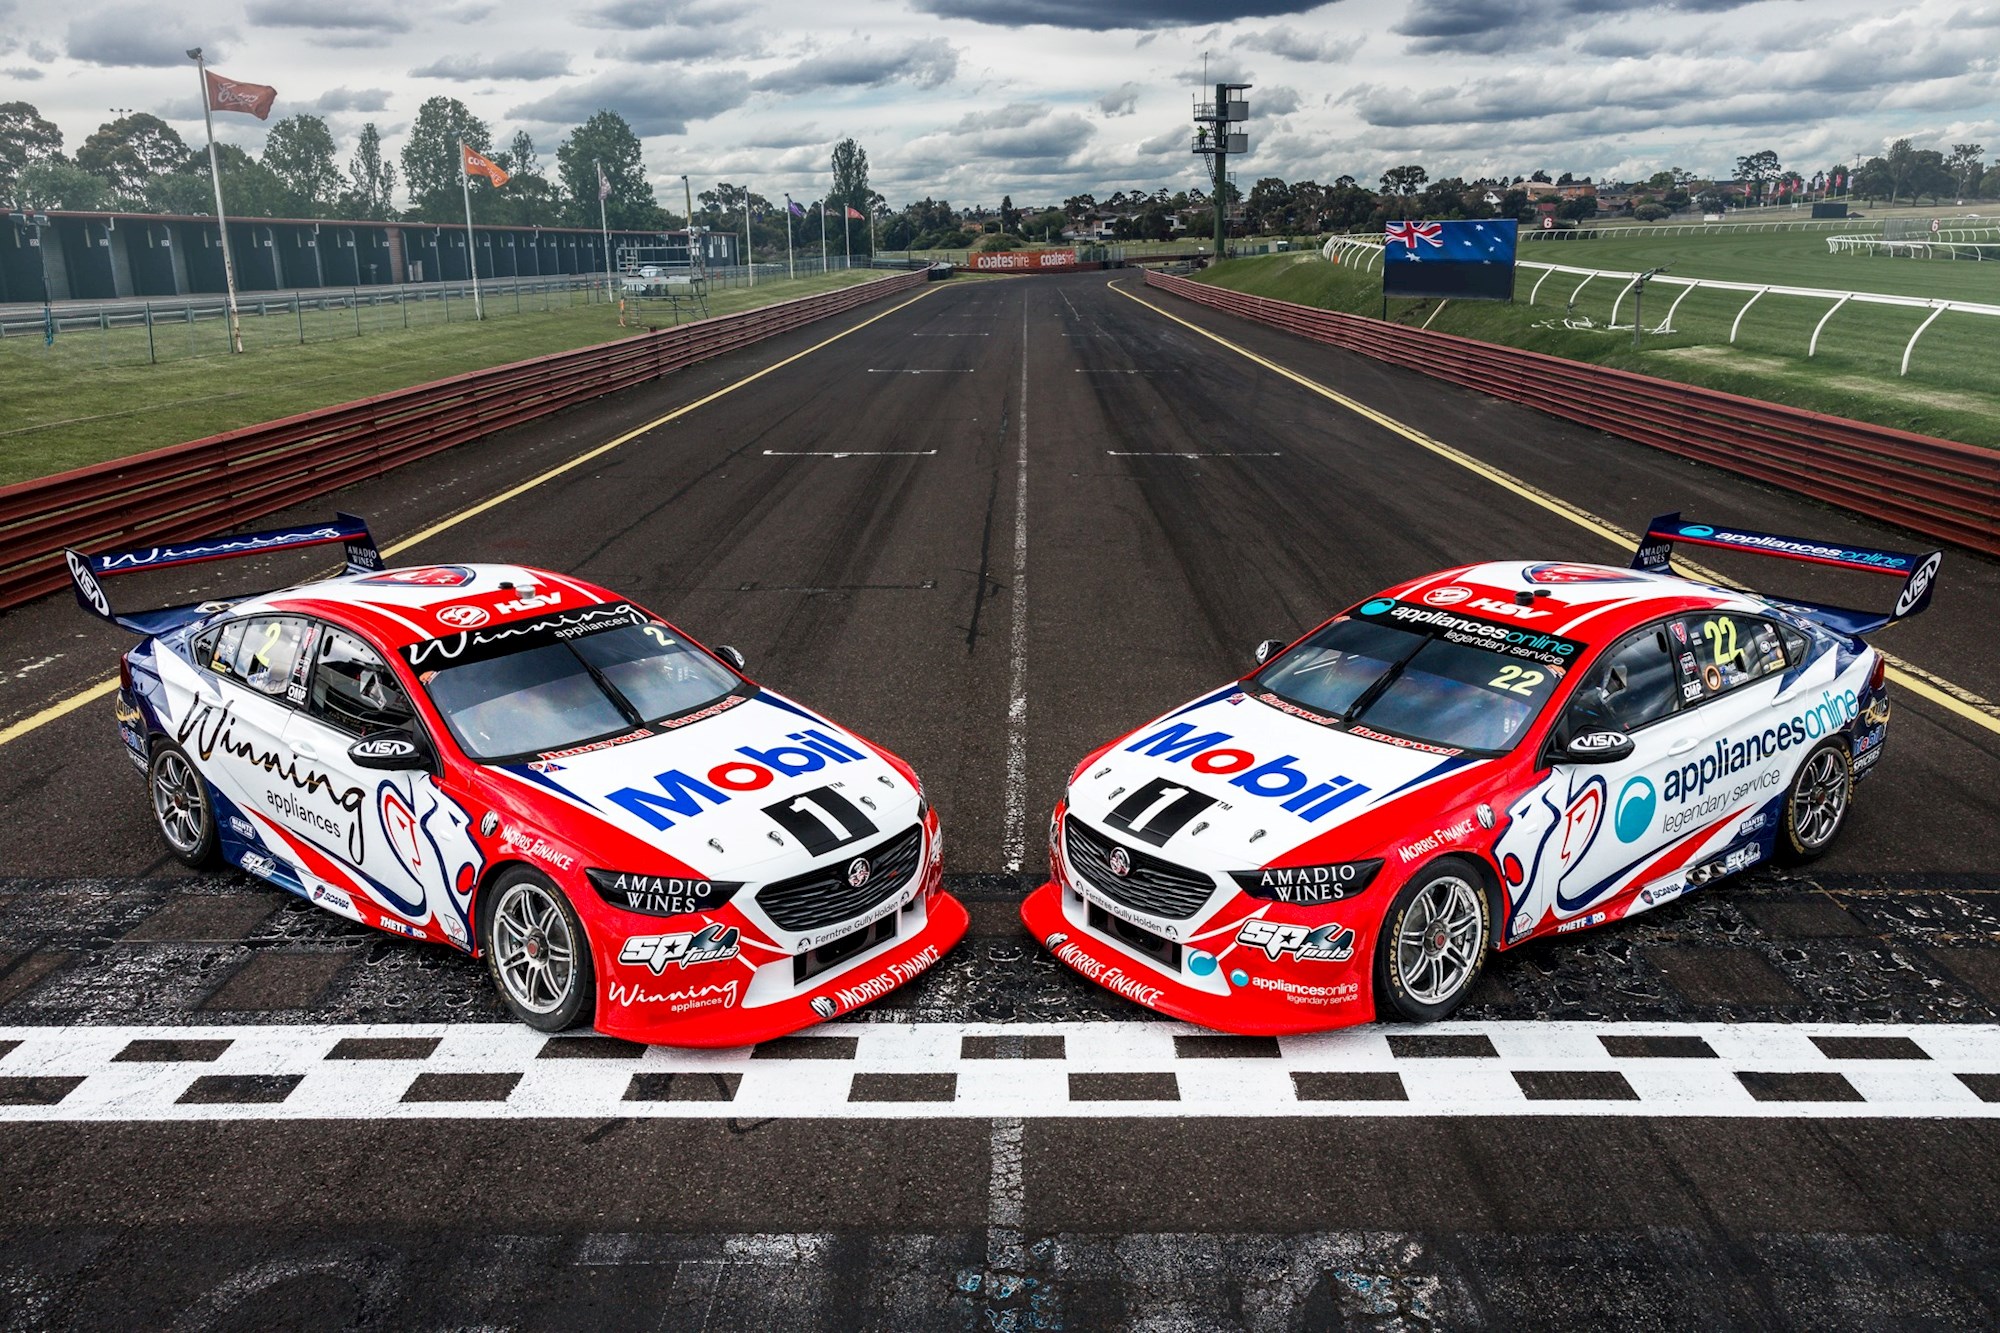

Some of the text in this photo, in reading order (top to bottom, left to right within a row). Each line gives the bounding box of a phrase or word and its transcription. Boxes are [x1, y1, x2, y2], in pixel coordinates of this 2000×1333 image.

[1543, 217, 1553, 229] 6
[1931, 219, 1940, 232] 6
[102, 527, 341, 569] Winning
[347, 545, 377, 560] AMADIO
[351, 554, 374, 568] WINES
[1639, 543, 1671, 559] AMADIO
[1643, 552, 1666, 566] WINES
[1715, 530, 1906, 568] appliancesonline
[493, 591, 562, 615] HSV
[1466, 597, 1553, 620] HSV
[409, 603, 649, 666] Winning
[554, 615, 630, 639] appliances
[643, 626, 676, 647] 2
[1390, 604, 1575, 656] appliancesonline
[1703, 616, 1746, 666] 22
[255, 622, 281, 666] 2
[1443, 629, 1565, 666] legendary service
[287, 684, 307, 701] OMP
[1487, 664, 1545, 697] 22
[1683, 682, 1703, 699] OMP
[658, 694, 747, 729] Honeywell
[366, 741, 402, 756] VISA
[537, 728, 655, 761] Honeywell
[1348, 725, 1465, 757] Honeywell
[1663, 688, 1859, 804] appliancesonline
[1124, 722, 1372, 823] Mobil
[1854, 745, 1881, 773] SPICERS
[177, 690, 366, 866] Winning
[604, 729, 868, 832] Mobil
[266, 787, 342, 839] appliances
[1127, 786, 1189, 833] 1
[1662, 788, 1731, 835] legendary
[1731, 767, 1781, 803] service
[789, 795, 853, 842] 1
[500, 824, 574, 872] MORRIS FINANCE
[1398, 818, 1475, 864] MORRIS FINANCE
[614, 873, 712, 898] AMADIO
[1260, 864, 1355, 887] AMADIO
[1652, 883, 1682, 899] SCANIA
[323, 891, 350, 910] SCANIA
[627, 891, 696, 914] WINES
[1274, 882, 1344, 902] WINES
[380, 914, 428, 939] THETFORD
[815, 900, 899, 945] Ferntree Gully Holden
[1085, 889, 1163, 933] Ferntree Gully Holden
[1557, 911, 1607, 933] THETFORD
[620, 933, 694, 975] SP
[680, 944, 739, 968] tools
[1237, 920, 1311, 961] SP
[1294, 942, 1353, 961] tools
[1390, 909, 1404, 988] DUNLOP
[834, 943, 941, 1010] MORRIS FINANCE
[1057, 942, 1165, 1007] MORRIS FINANCE
[1252, 976, 1359, 997] appliancesonline
[608, 979, 739, 1009] Winning
[671, 997, 723, 1012] appliances
[1287, 992, 1358, 1007] legendary service
